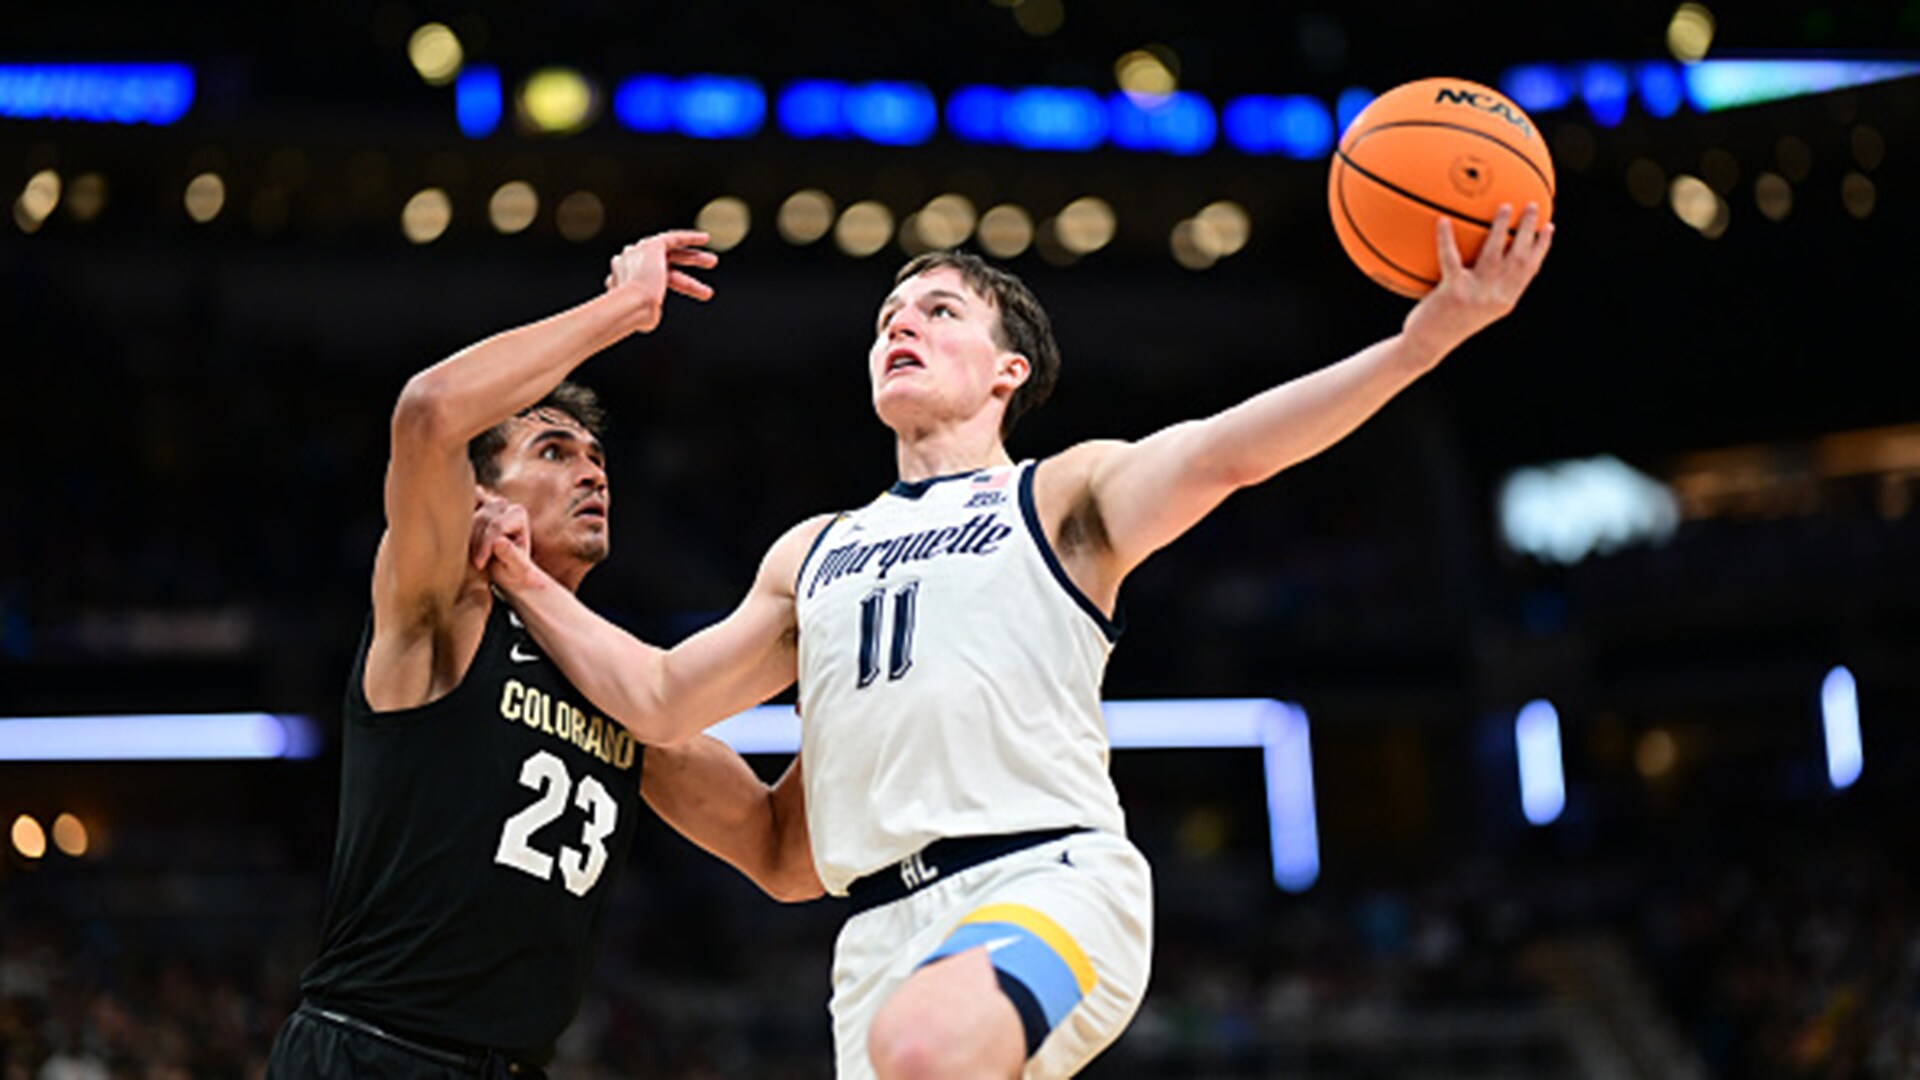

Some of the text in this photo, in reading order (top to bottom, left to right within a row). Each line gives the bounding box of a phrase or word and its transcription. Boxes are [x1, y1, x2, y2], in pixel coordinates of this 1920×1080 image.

[1434, 87, 1532, 138] NCAA
[807, 512, 1012, 598] Marquette
[857, 581, 919, 689] 11
[494, 749, 618, 897] 23
